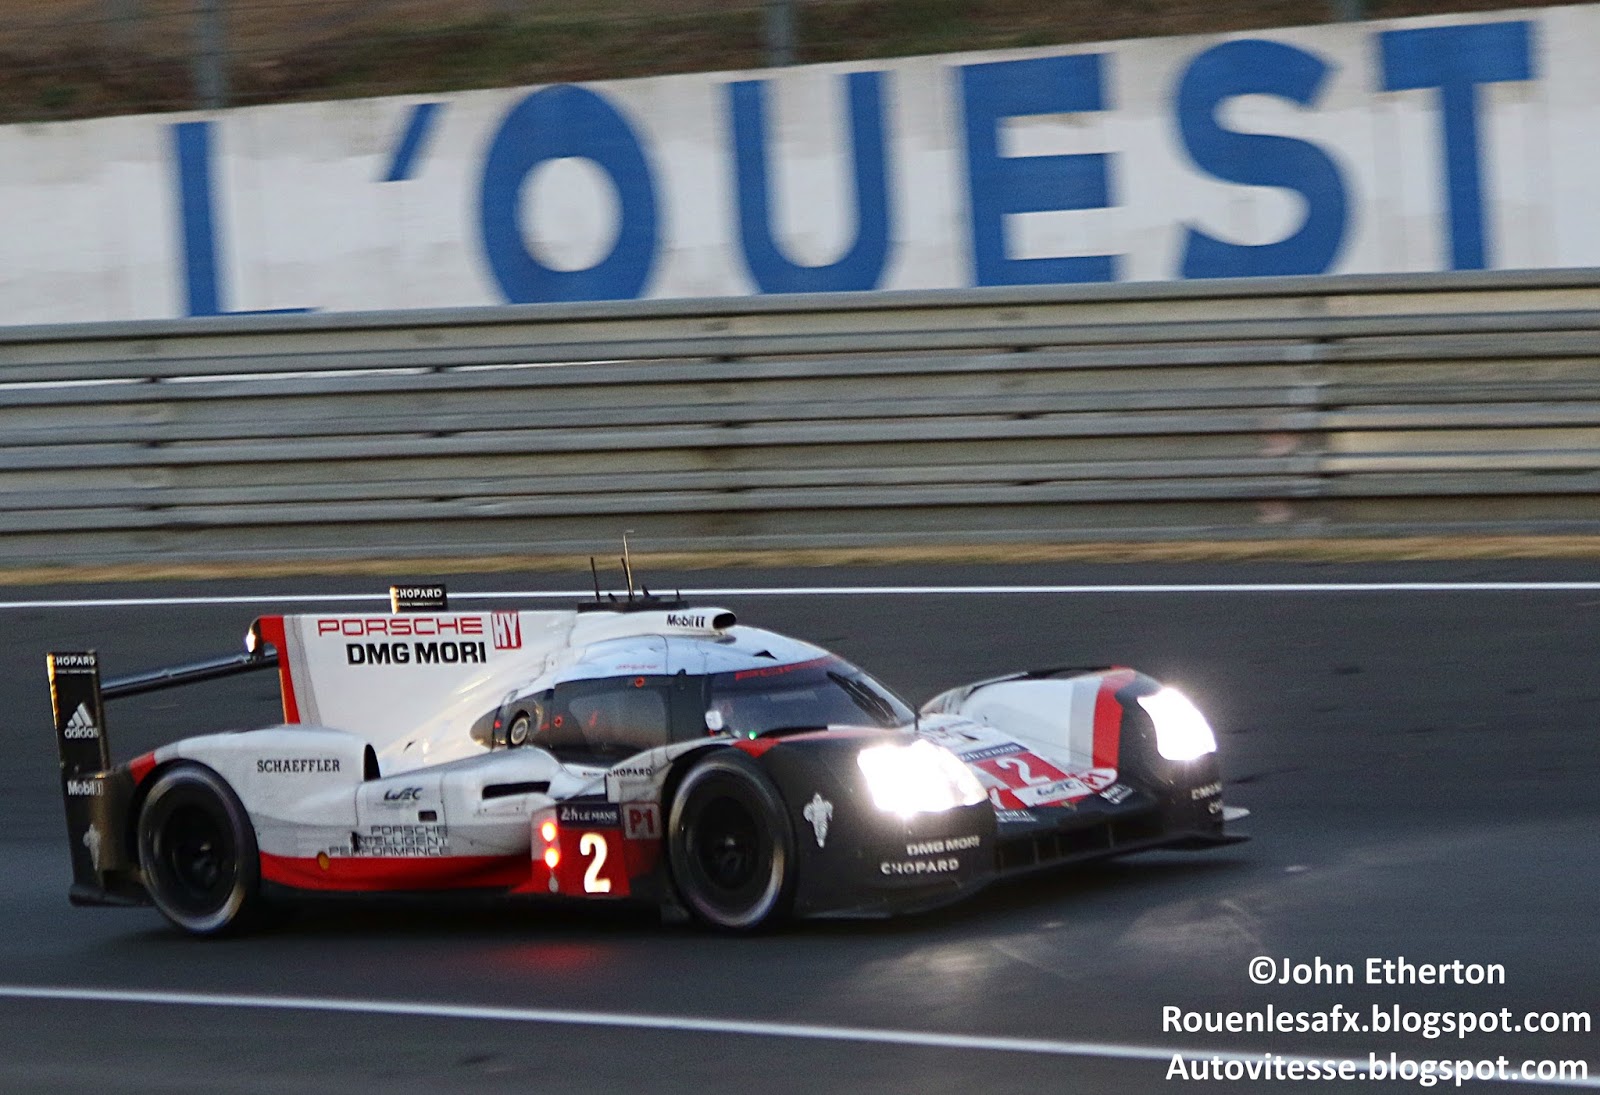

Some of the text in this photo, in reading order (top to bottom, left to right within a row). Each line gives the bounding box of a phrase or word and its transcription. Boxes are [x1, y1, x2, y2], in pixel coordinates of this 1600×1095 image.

[166, 20, 1540, 318] L'OUEST
[317, 617, 483, 637] PORSCHE
[666, 614, 694, 628] Mobil
[54, 656, 96, 666] HOPARD
[346, 641, 487, 665] DMG MORI
[64, 726, 99, 739] adidas
[256, 759, 341, 773] SCHAEFFLER
[993, 757, 1053, 787] 2
[67, 780, 94, 796] Mobil
[384, 787, 423, 801] WEC
[628, 808, 655, 834] P1
[370, 825, 448, 837] PORSCHE
[352, 836, 448, 847] NTELLIGENT
[906, 835, 981, 857] DMG MORI
[579, 832, 612, 893] 2
[880, 858, 960, 876] CHOPARD
